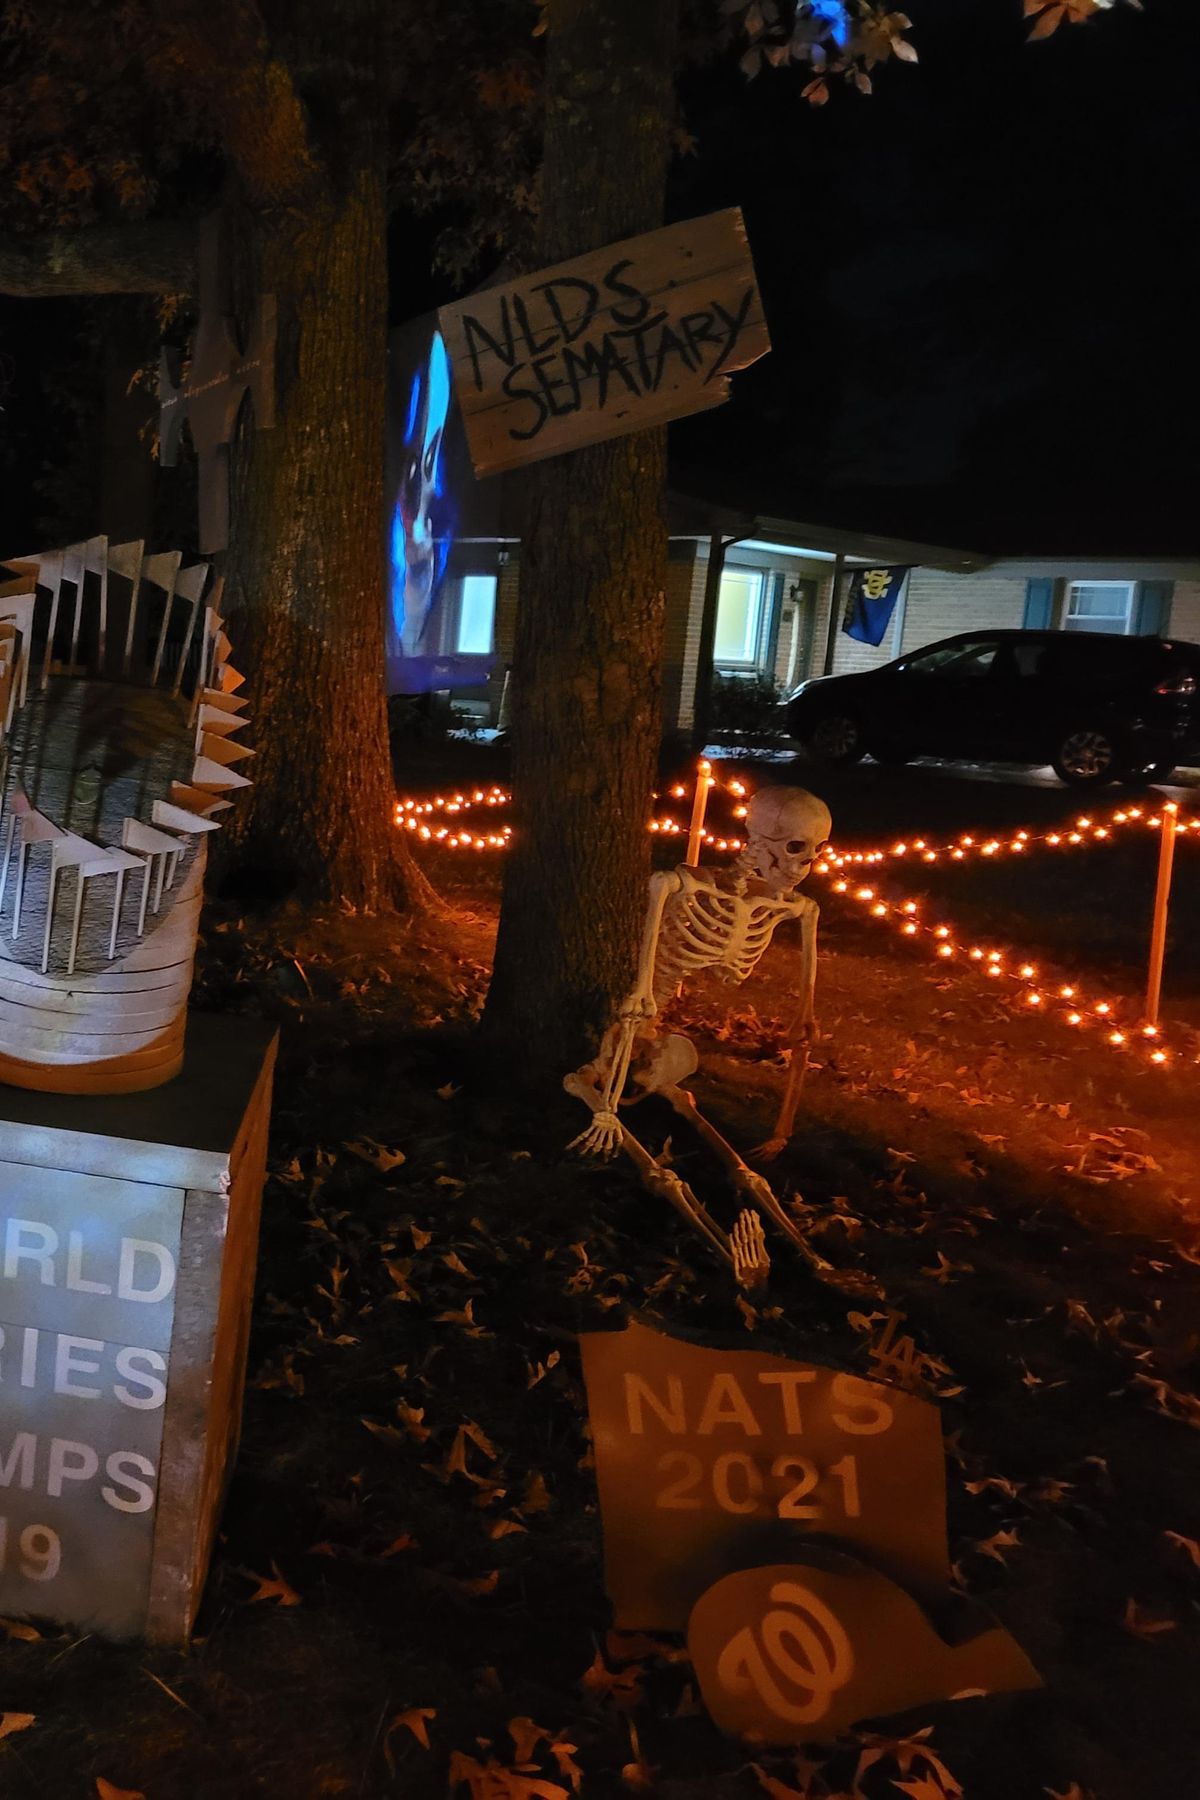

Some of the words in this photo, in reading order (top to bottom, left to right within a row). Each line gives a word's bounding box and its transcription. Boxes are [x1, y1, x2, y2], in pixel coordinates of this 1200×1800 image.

[462, 259, 650, 392] NLDS
[502, 288, 754, 440] SEMATARY
[623, 1371, 895, 1436] NATS
[655, 1450, 862, 1519] 2021
